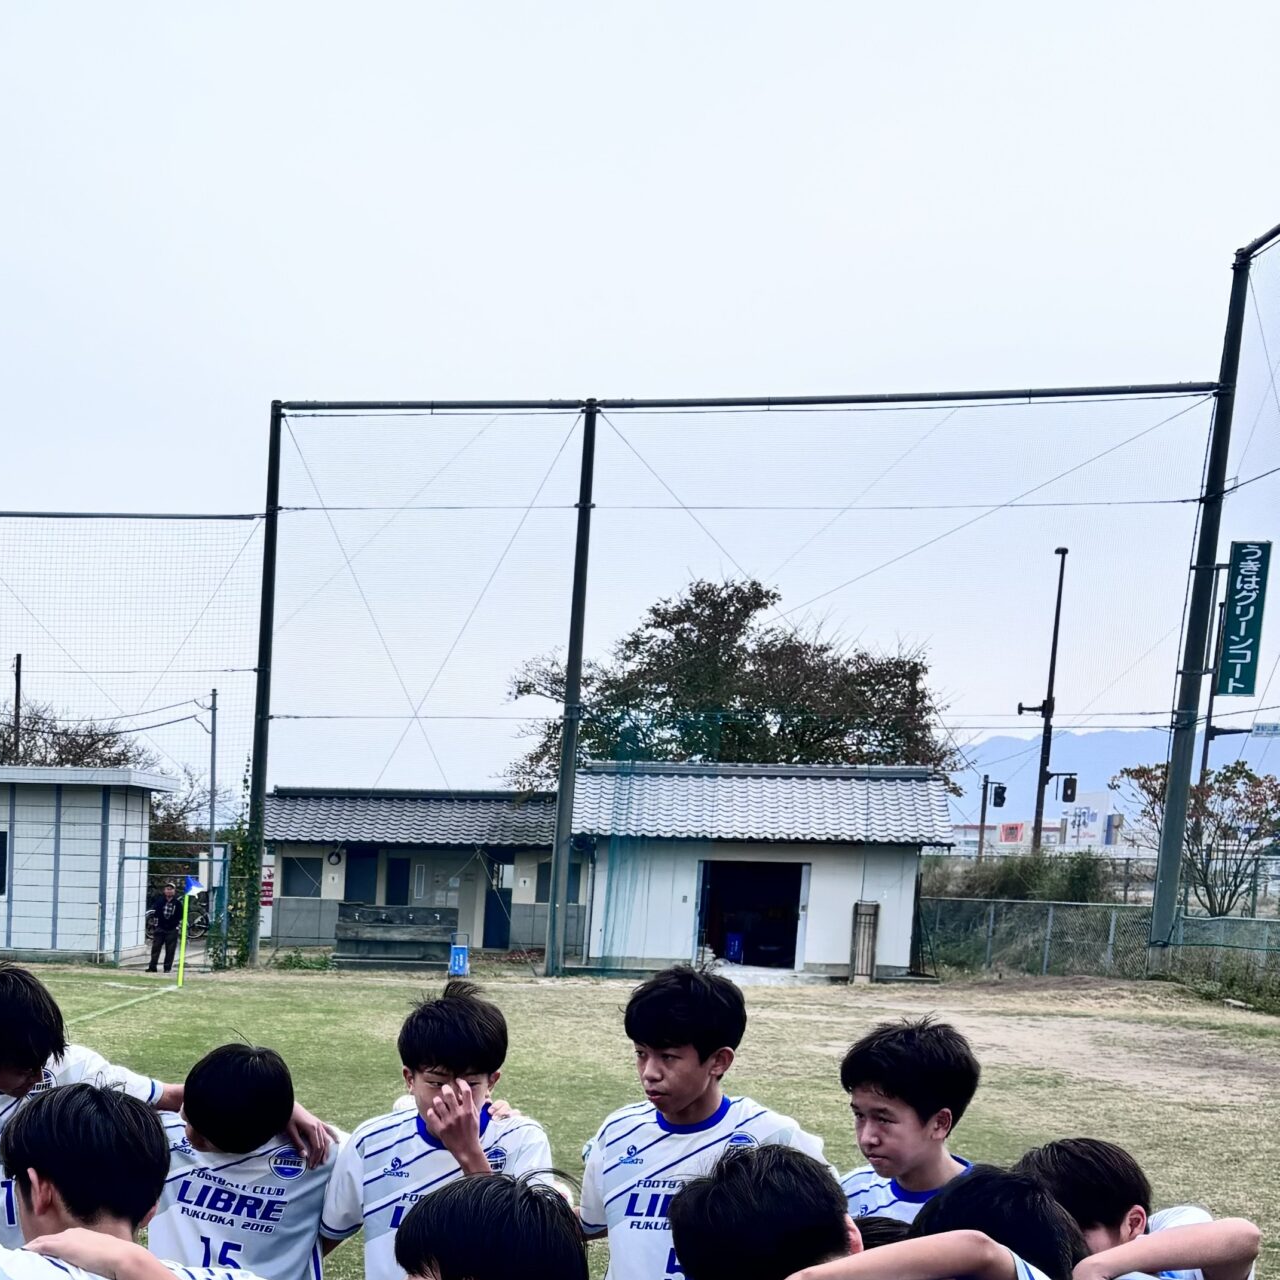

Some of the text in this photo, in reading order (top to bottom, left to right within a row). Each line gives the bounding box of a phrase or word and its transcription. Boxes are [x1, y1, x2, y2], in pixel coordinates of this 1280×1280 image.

[1228, 544, 1262, 693] うきはグリーンコート
[273, 1159, 302, 1167] LIBRE
[636, 1180, 685, 1188] FOOTBA
[252, 1185, 285, 1196] CLUB
[177, 1180, 287, 1222] LIBRE
[181, 1207, 275, 1233] FUKUOKA 2016
[630, 1221, 671, 1230] FUKUO
